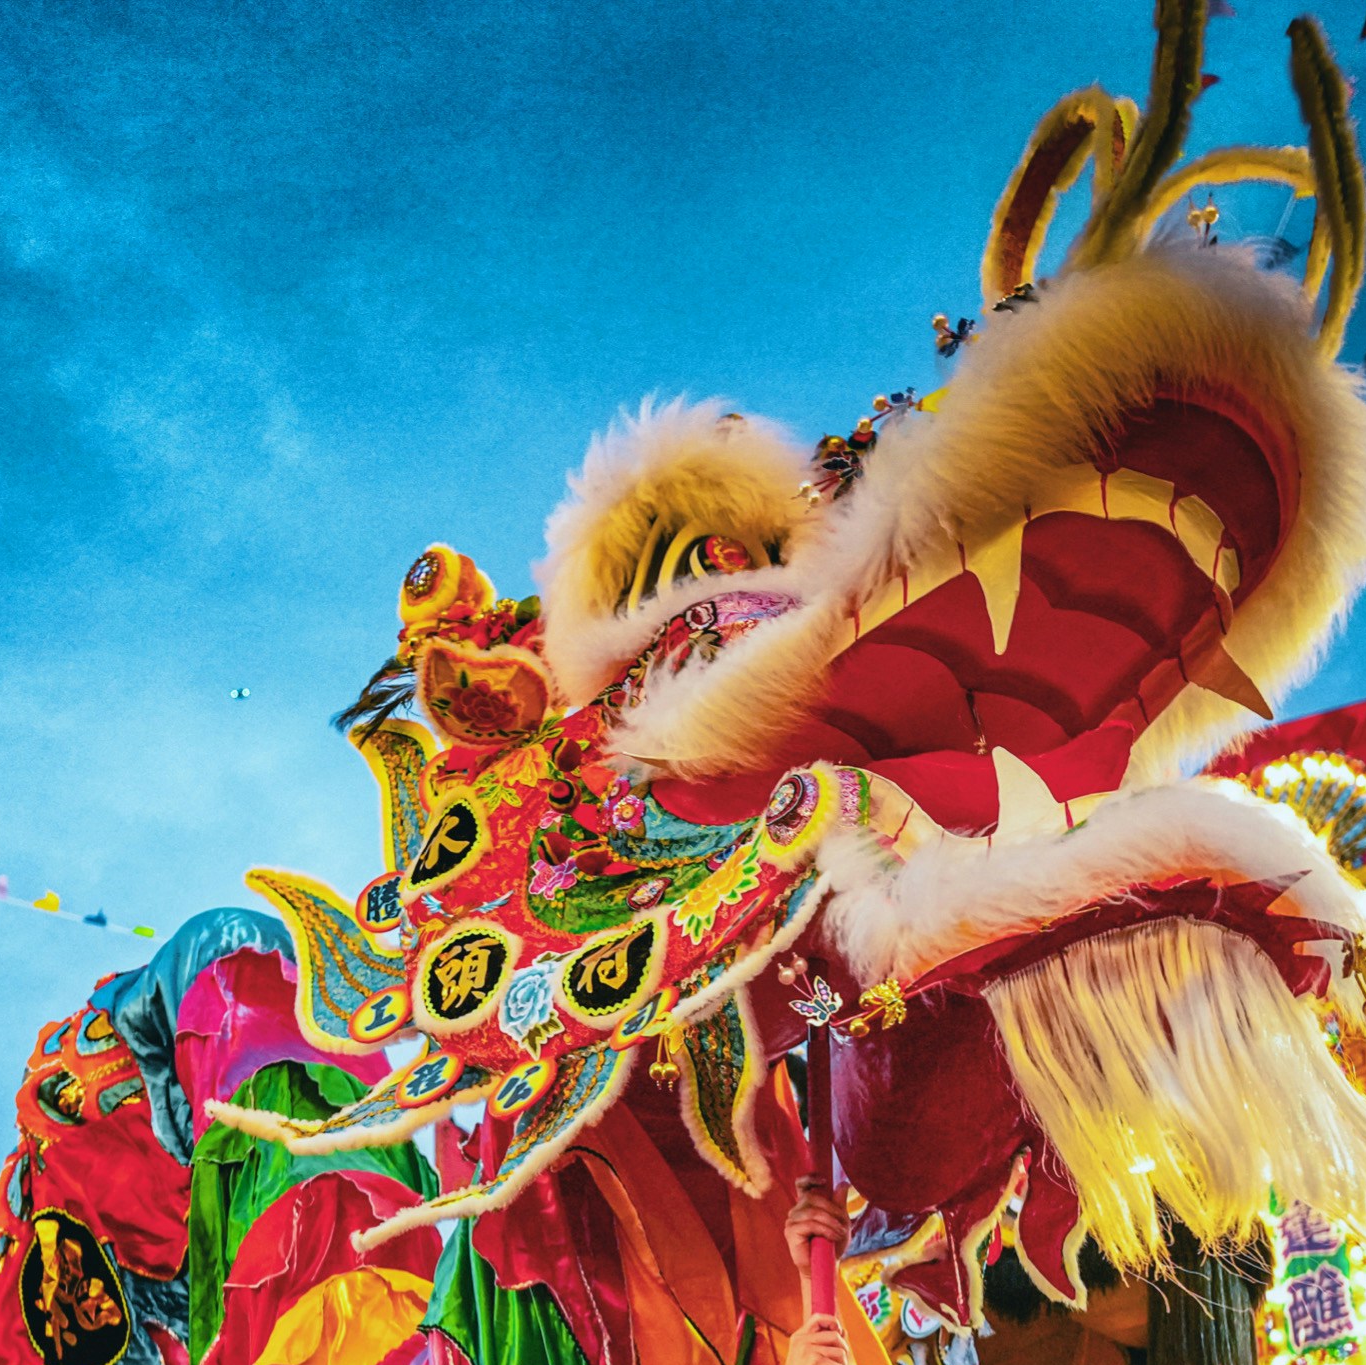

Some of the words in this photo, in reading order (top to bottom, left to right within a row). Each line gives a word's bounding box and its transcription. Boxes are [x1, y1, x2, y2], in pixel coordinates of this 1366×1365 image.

[435, 937, 499, 1012] 頭
[365, 994, 398, 1033] 工
[406, 1056, 449, 1099] 程
